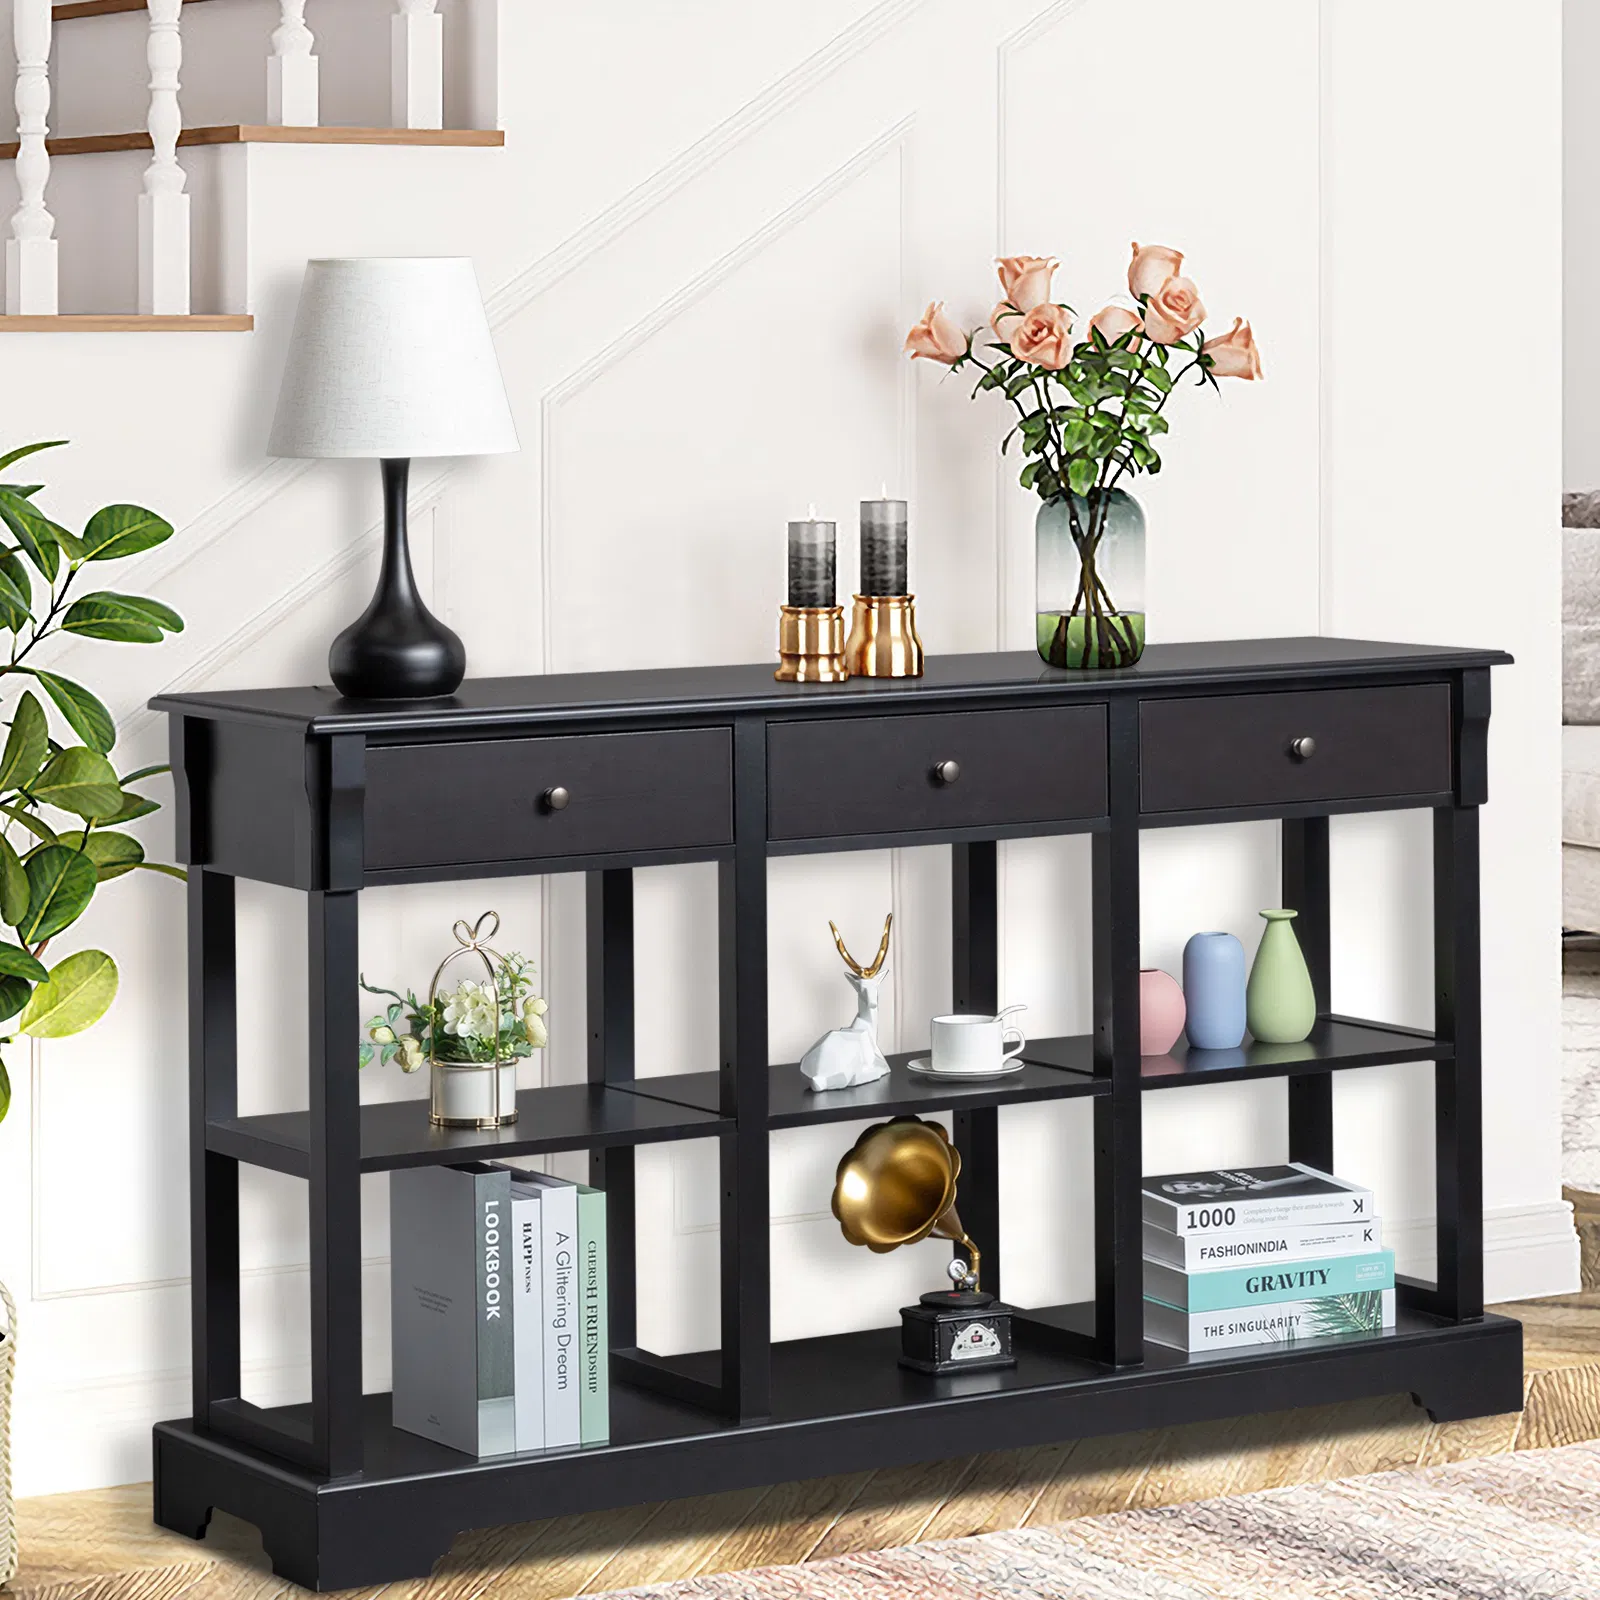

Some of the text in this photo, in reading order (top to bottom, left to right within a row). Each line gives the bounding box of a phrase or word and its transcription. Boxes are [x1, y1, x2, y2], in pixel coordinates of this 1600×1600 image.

[1187, 1207, 1236, 1229] 1000
[1363, 1228, 1373, 1242] K
[485, 1200, 501, 1321] LOOKBOOK
[1200, 1239, 1288, 1260] FASHIONINDIA
[1245, 1268, 1331, 1294] GRAVITY
[552, 1231, 572, 1390] A Glittering Dream
[586, 1240, 598, 1393] CHERISH FRIENDSHIP
[1204, 1315, 1302, 1338] THE SINGULARITY
